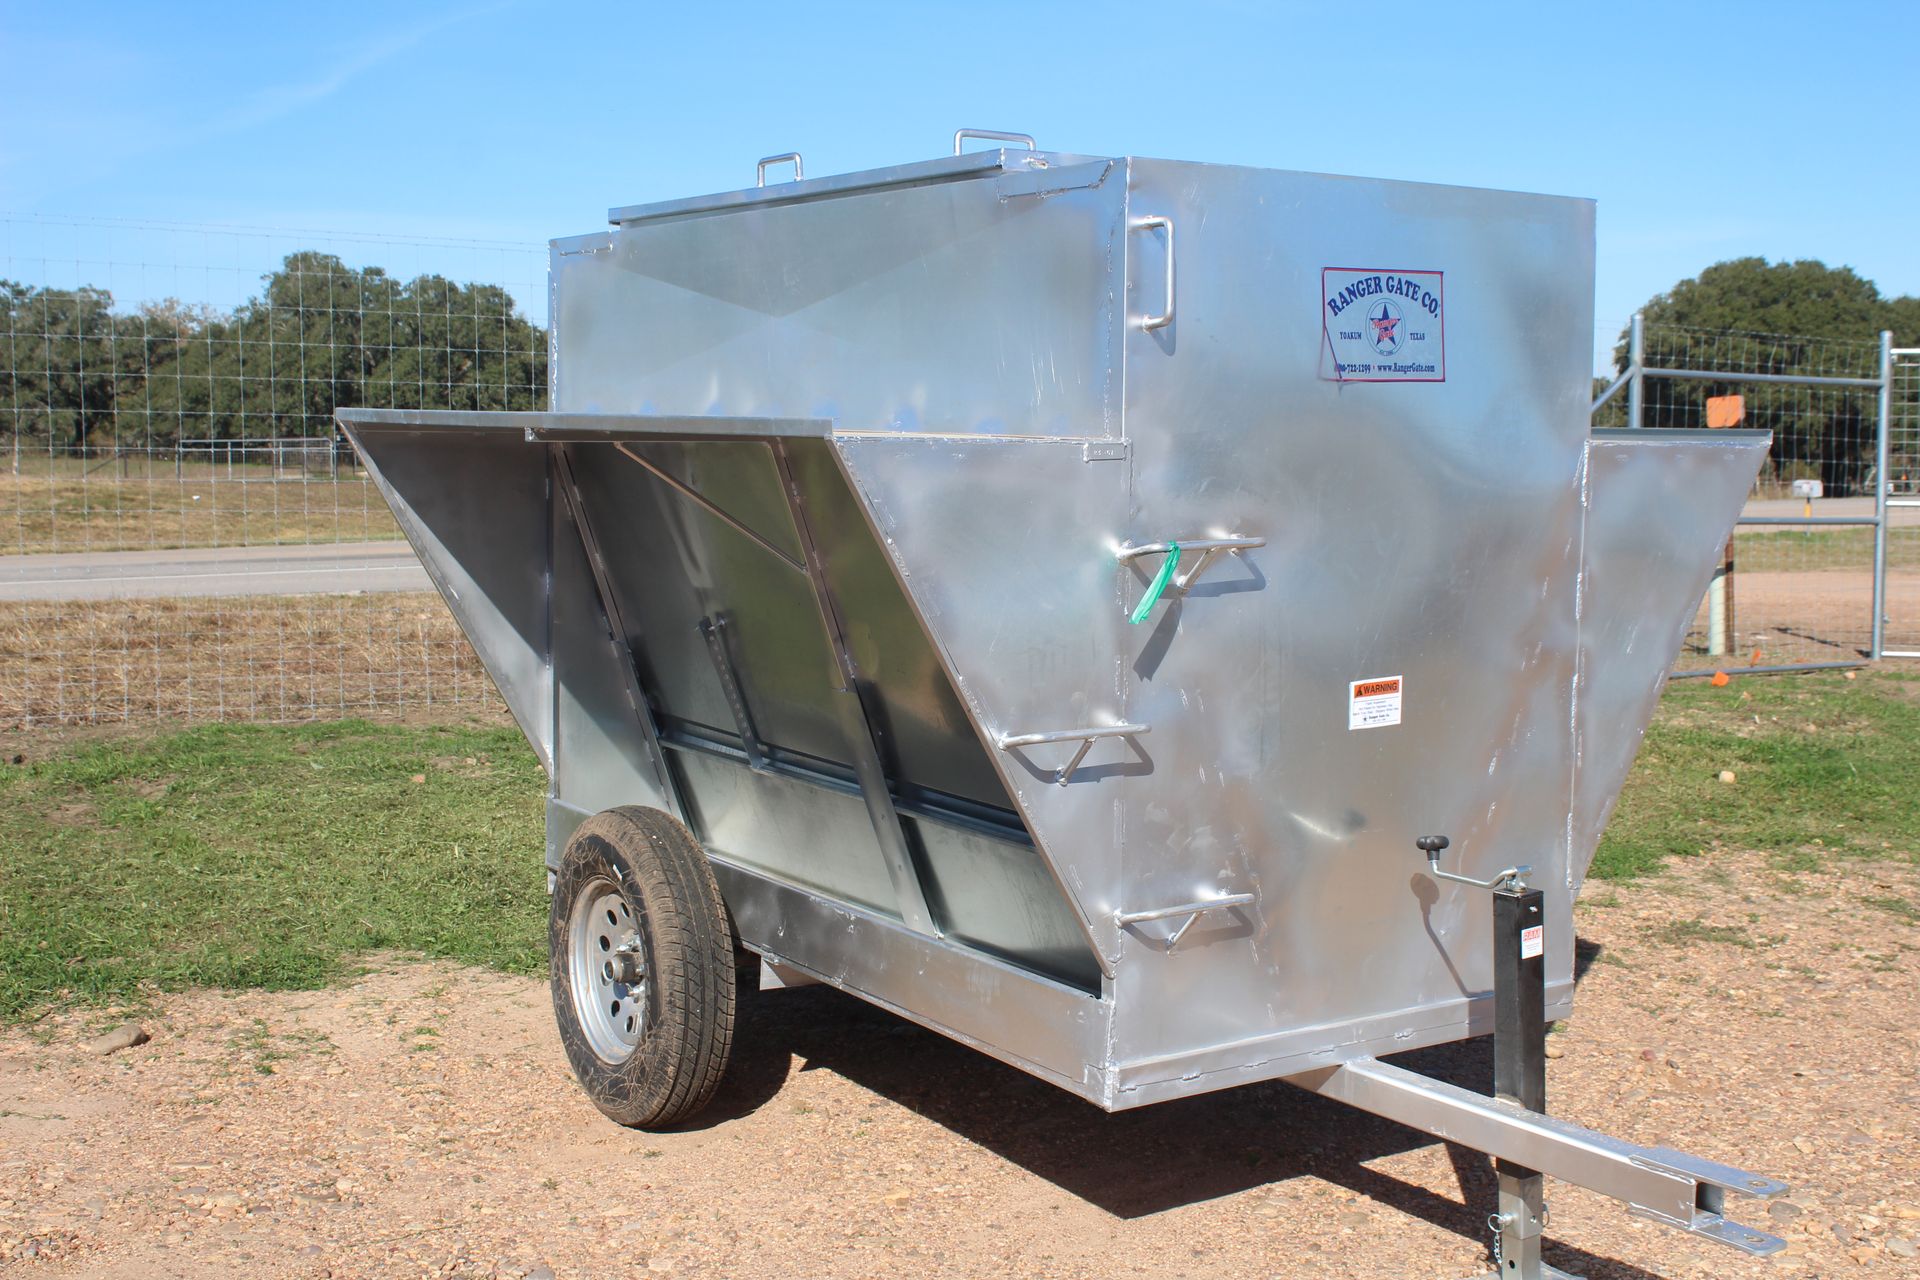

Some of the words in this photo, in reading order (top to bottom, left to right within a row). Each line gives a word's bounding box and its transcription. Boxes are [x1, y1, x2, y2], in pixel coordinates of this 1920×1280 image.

[1327, 276, 1383, 316] RANGER
[1386, 276, 1420, 301] GATE
[1421, 292, 1438, 318] CO.
[1339, 331, 1362, 340] YOAKUM
[1409, 333, 1425, 341] TEXAS
[1377, 362, 1435, 374] www.RangerGate.com
[1363, 682, 1397, 694] WARNING
